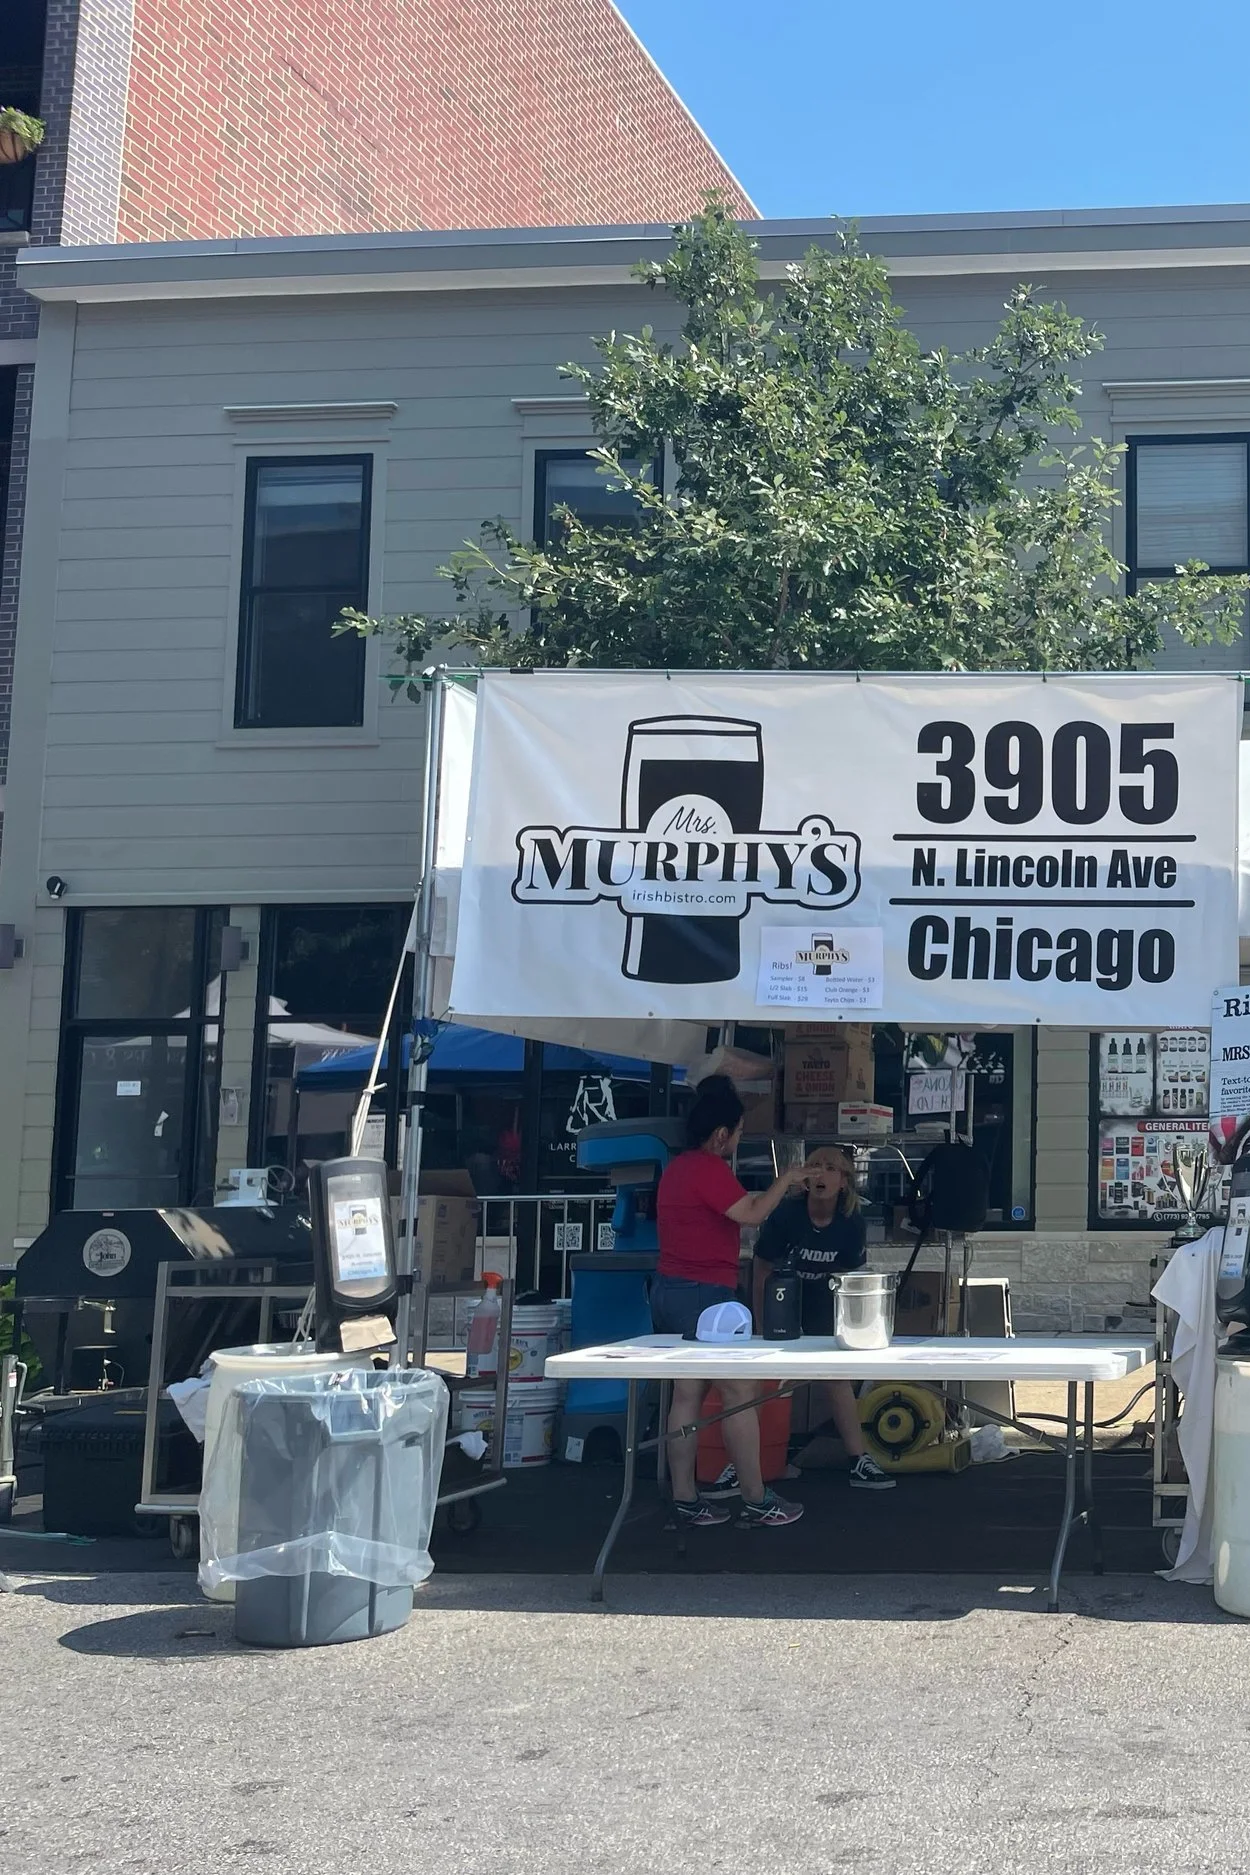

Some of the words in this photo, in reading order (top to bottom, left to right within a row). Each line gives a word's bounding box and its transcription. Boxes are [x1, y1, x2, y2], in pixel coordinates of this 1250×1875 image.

[917, 721, 1178, 825] 3905
[663, 806, 718, 835] Mrs.
[526, 827, 848, 896] MURPHY'S
[912, 848, 945, 887] N.
[956, 848, 1097, 888] Lincoln
[1107, 850, 1176, 888] Ave
[632, 889, 736, 904] irishbistro.com
[772, 962, 793, 970] Ribs!
[908, 915, 1174, 992] Chicago
[795, 1070, 835, 1081] CHEESE
[1145, 1122, 1191, 1131] GENERAL
